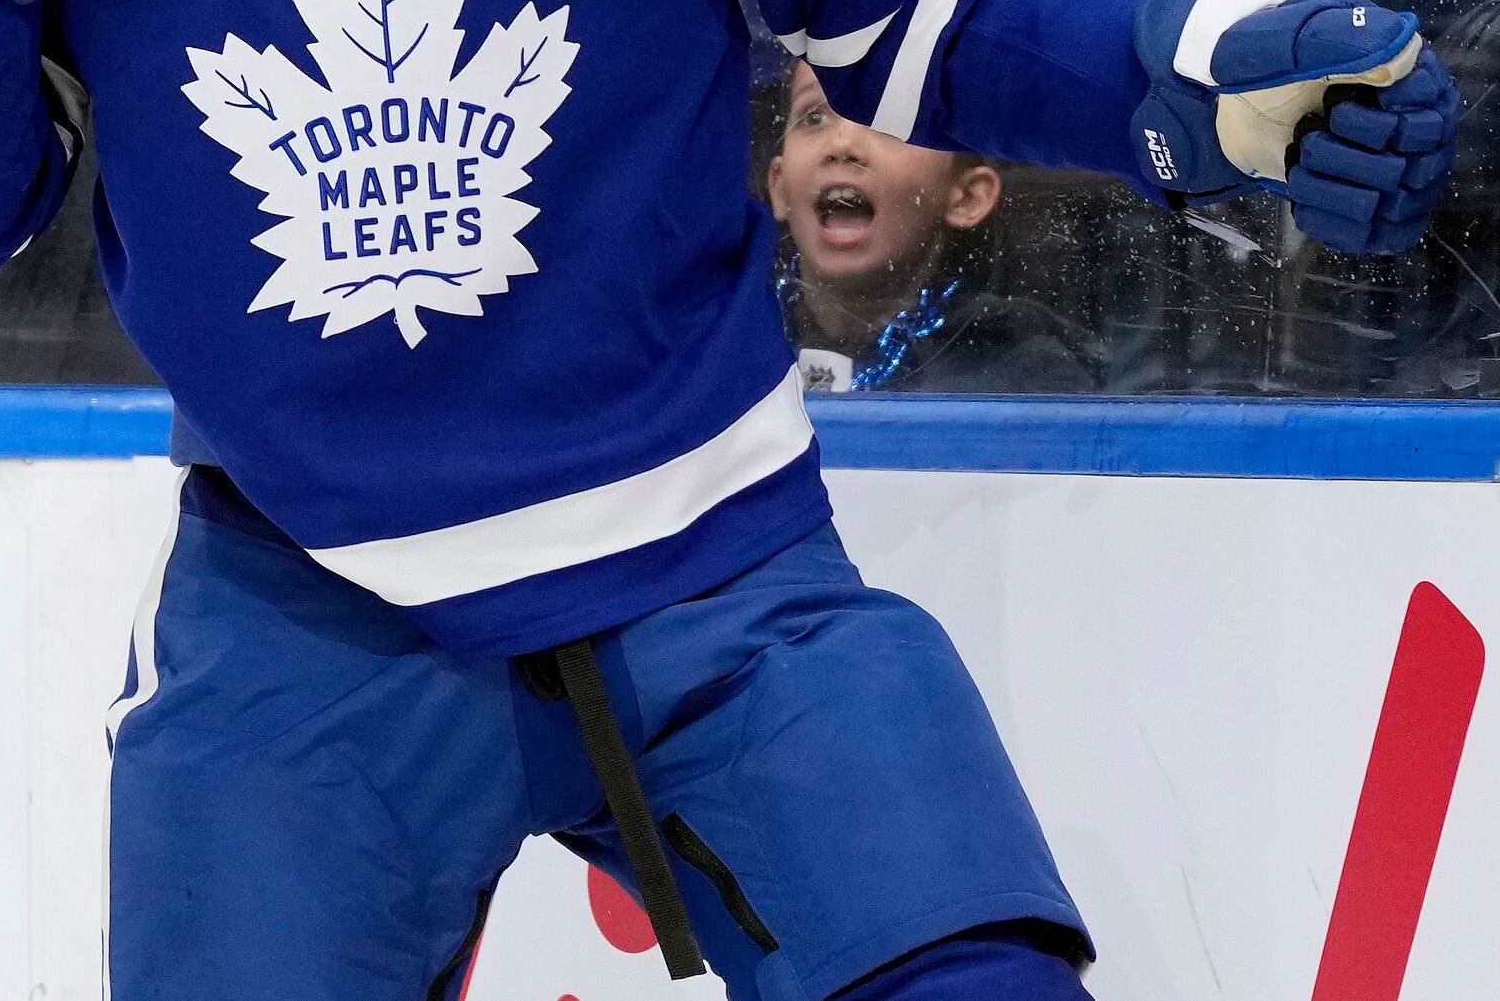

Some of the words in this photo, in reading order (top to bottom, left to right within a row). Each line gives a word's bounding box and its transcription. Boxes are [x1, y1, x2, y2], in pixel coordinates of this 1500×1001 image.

[269, 97, 515, 176] TORONTO
[1144, 128, 1172, 180] CCM
[317, 157, 481, 211] MAPLE
[322, 207, 482, 261] LEAFS
